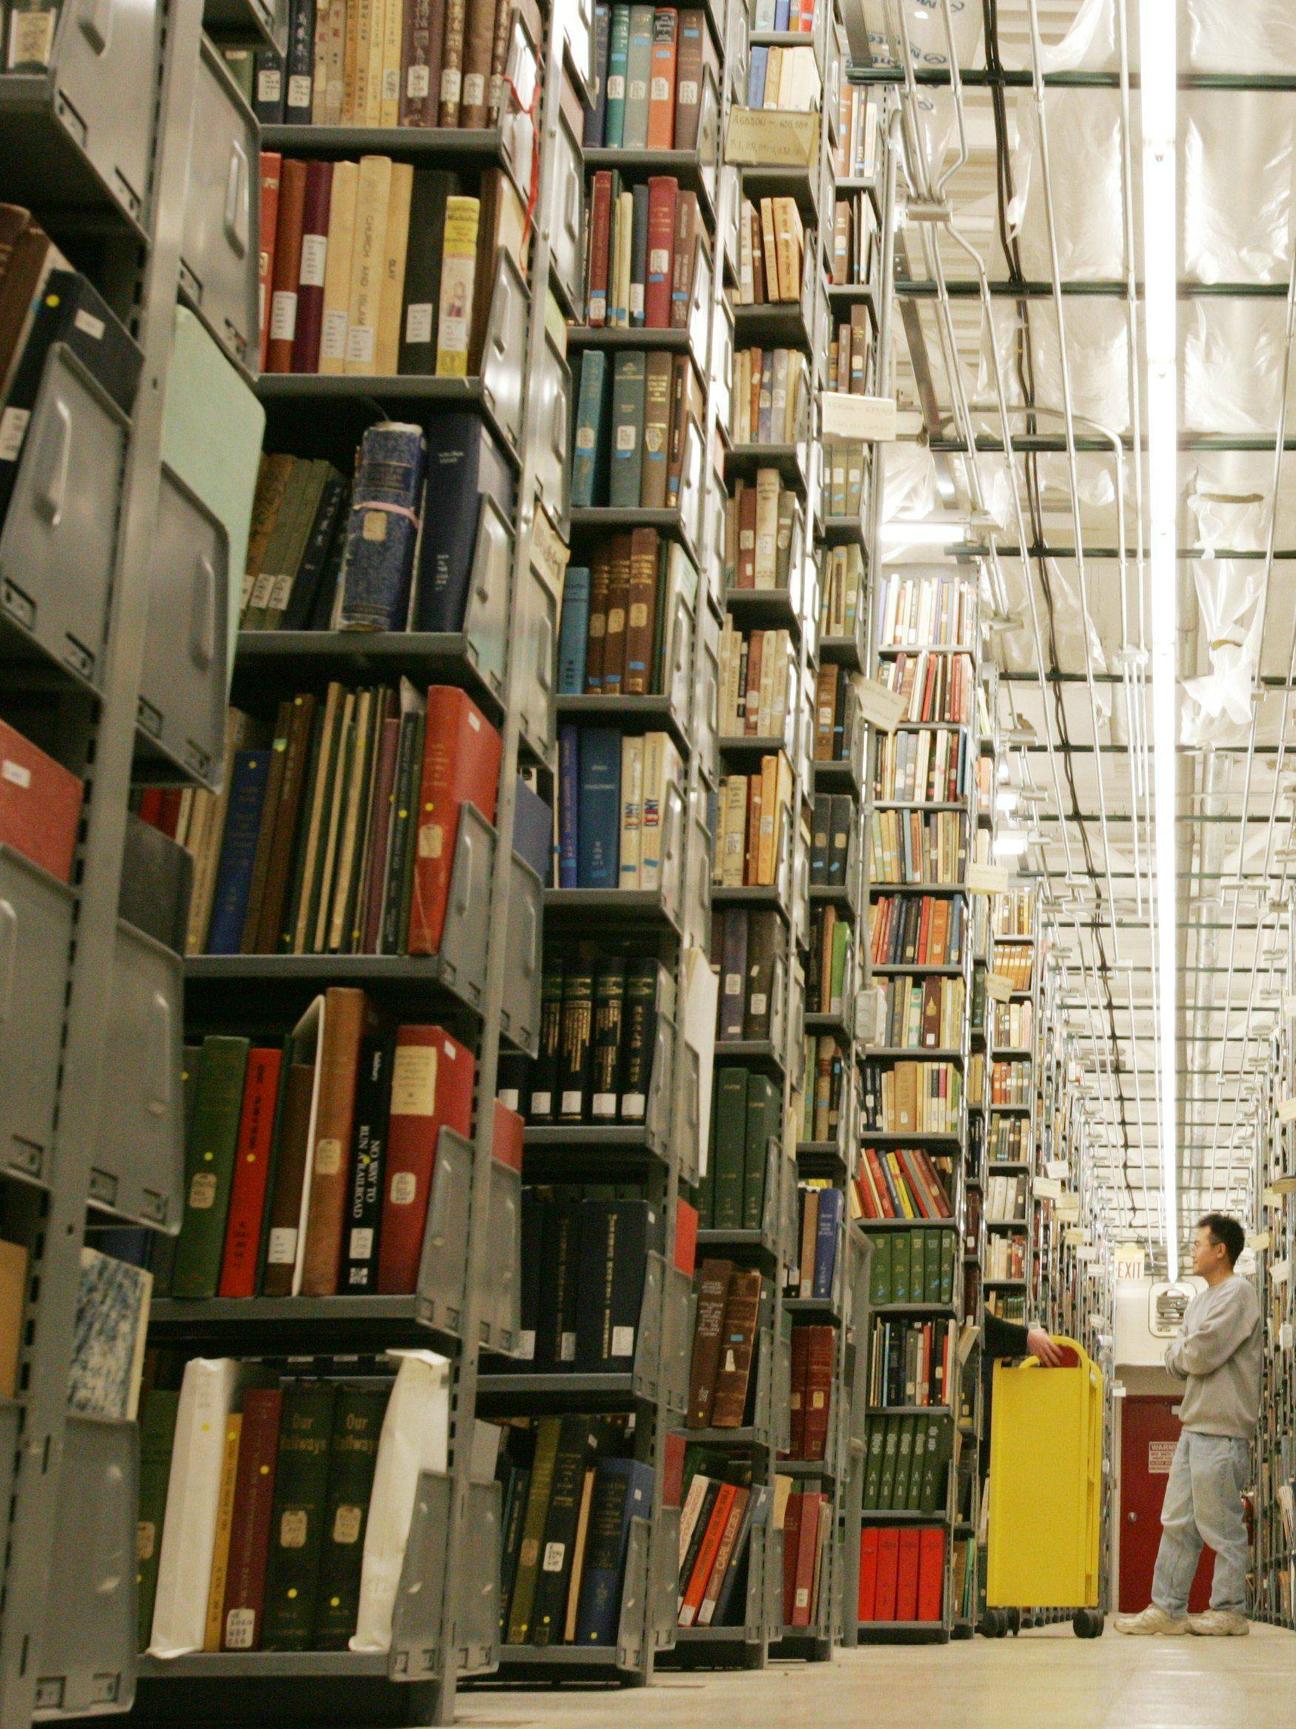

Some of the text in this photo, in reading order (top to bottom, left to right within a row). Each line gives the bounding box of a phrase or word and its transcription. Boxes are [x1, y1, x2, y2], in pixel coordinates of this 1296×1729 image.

[358, 1125, 370, 1150] RUN
[366, 1139, 380, 1203] NO WAY TO
[352, 1162, 367, 1219] RAILROAD
[1117, 1260, 1142, 1280] EXIT
[292, 1413, 314, 1430] Our
[346, 1413, 368, 1430] Our
